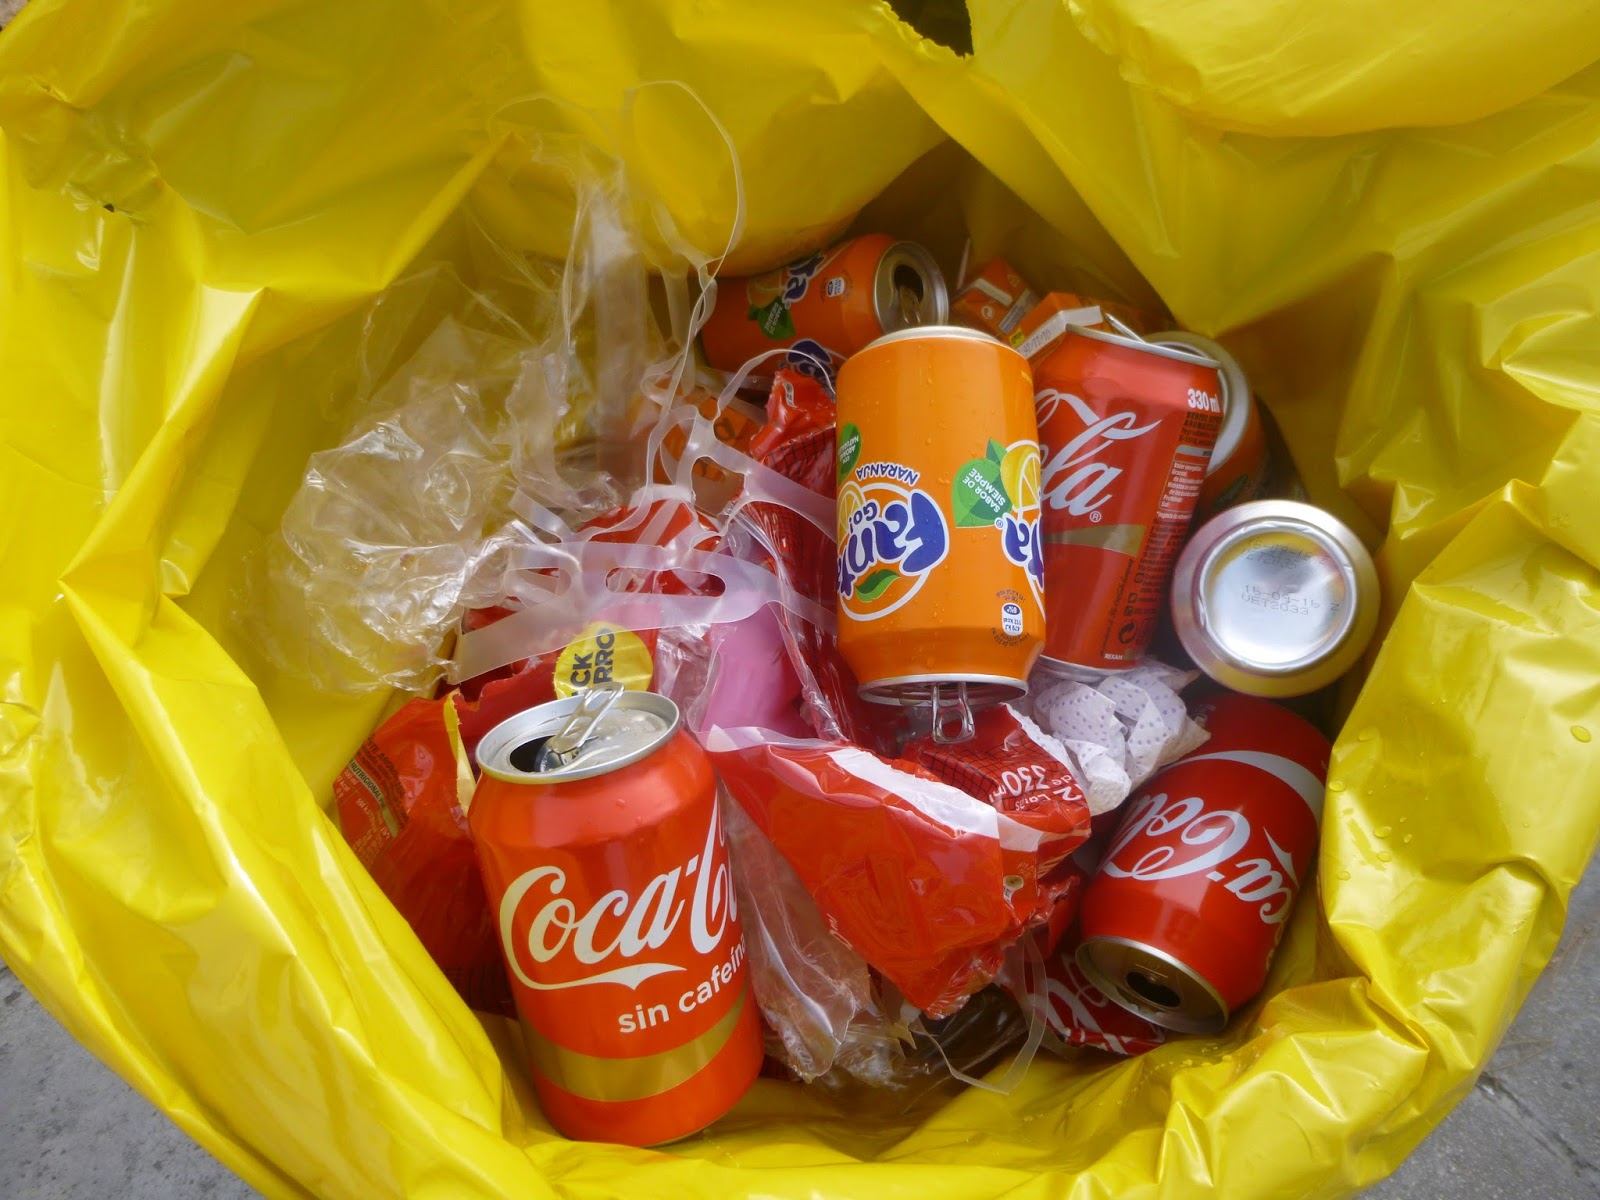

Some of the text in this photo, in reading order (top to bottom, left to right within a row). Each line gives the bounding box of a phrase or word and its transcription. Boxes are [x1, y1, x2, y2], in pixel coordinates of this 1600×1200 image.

[1187, 388, 1209, 412] 330
[856, 463, 920, 486] NARANJA
[968, 467, 1006, 506] SIEMPRE
[962, 475, 1002, 513] SABOR DE
[849, 501, 878, 534] GO!
[838, 489, 949, 598] Fant
[570, 652, 594, 697] CK
[593, 628, 615, 690] RRO
[349, 760, 382, 800] NUTRICIONAL
[1001, 764, 1050, 797] 330
[1052, 774, 1072, 786] de
[618, 1004, 670, 1034] sin
